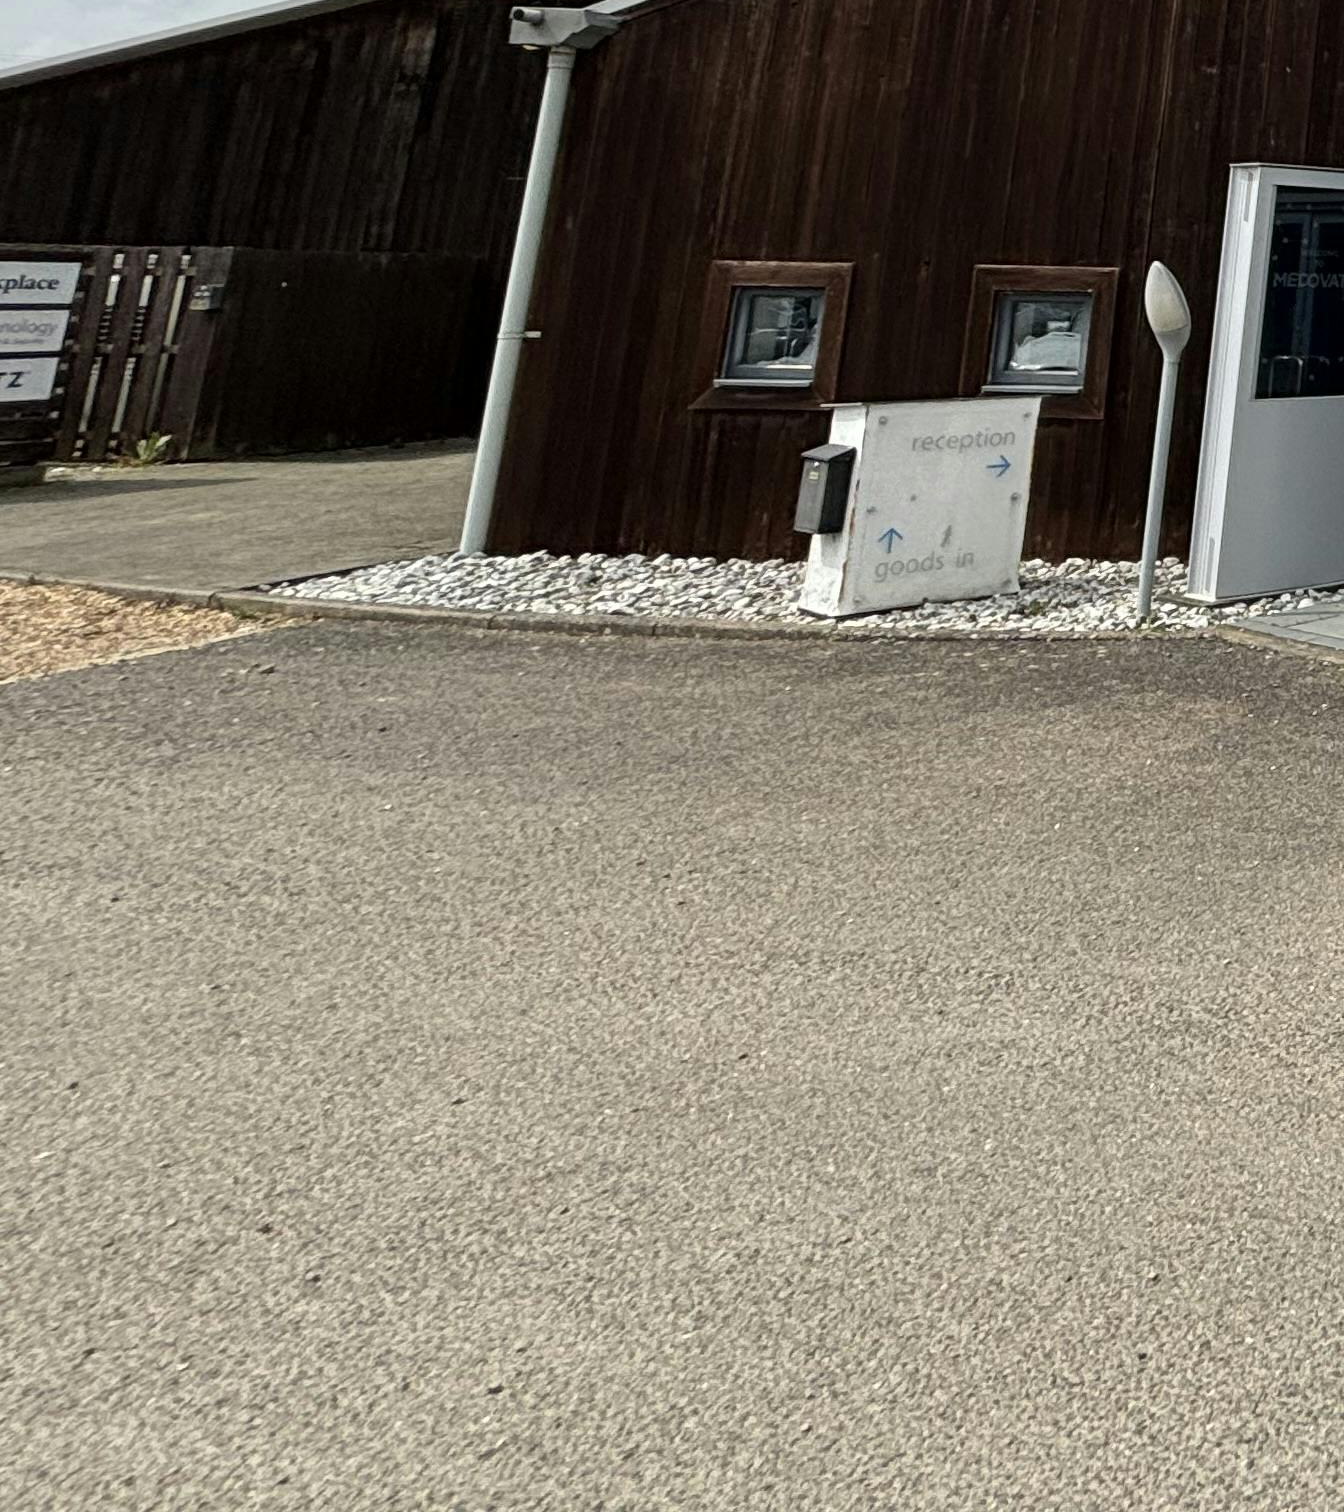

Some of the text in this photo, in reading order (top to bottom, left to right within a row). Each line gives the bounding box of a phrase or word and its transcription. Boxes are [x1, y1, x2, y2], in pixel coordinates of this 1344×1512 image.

[911, 427, 1016, 454] reception
[874, 547, 975, 583] goods in
